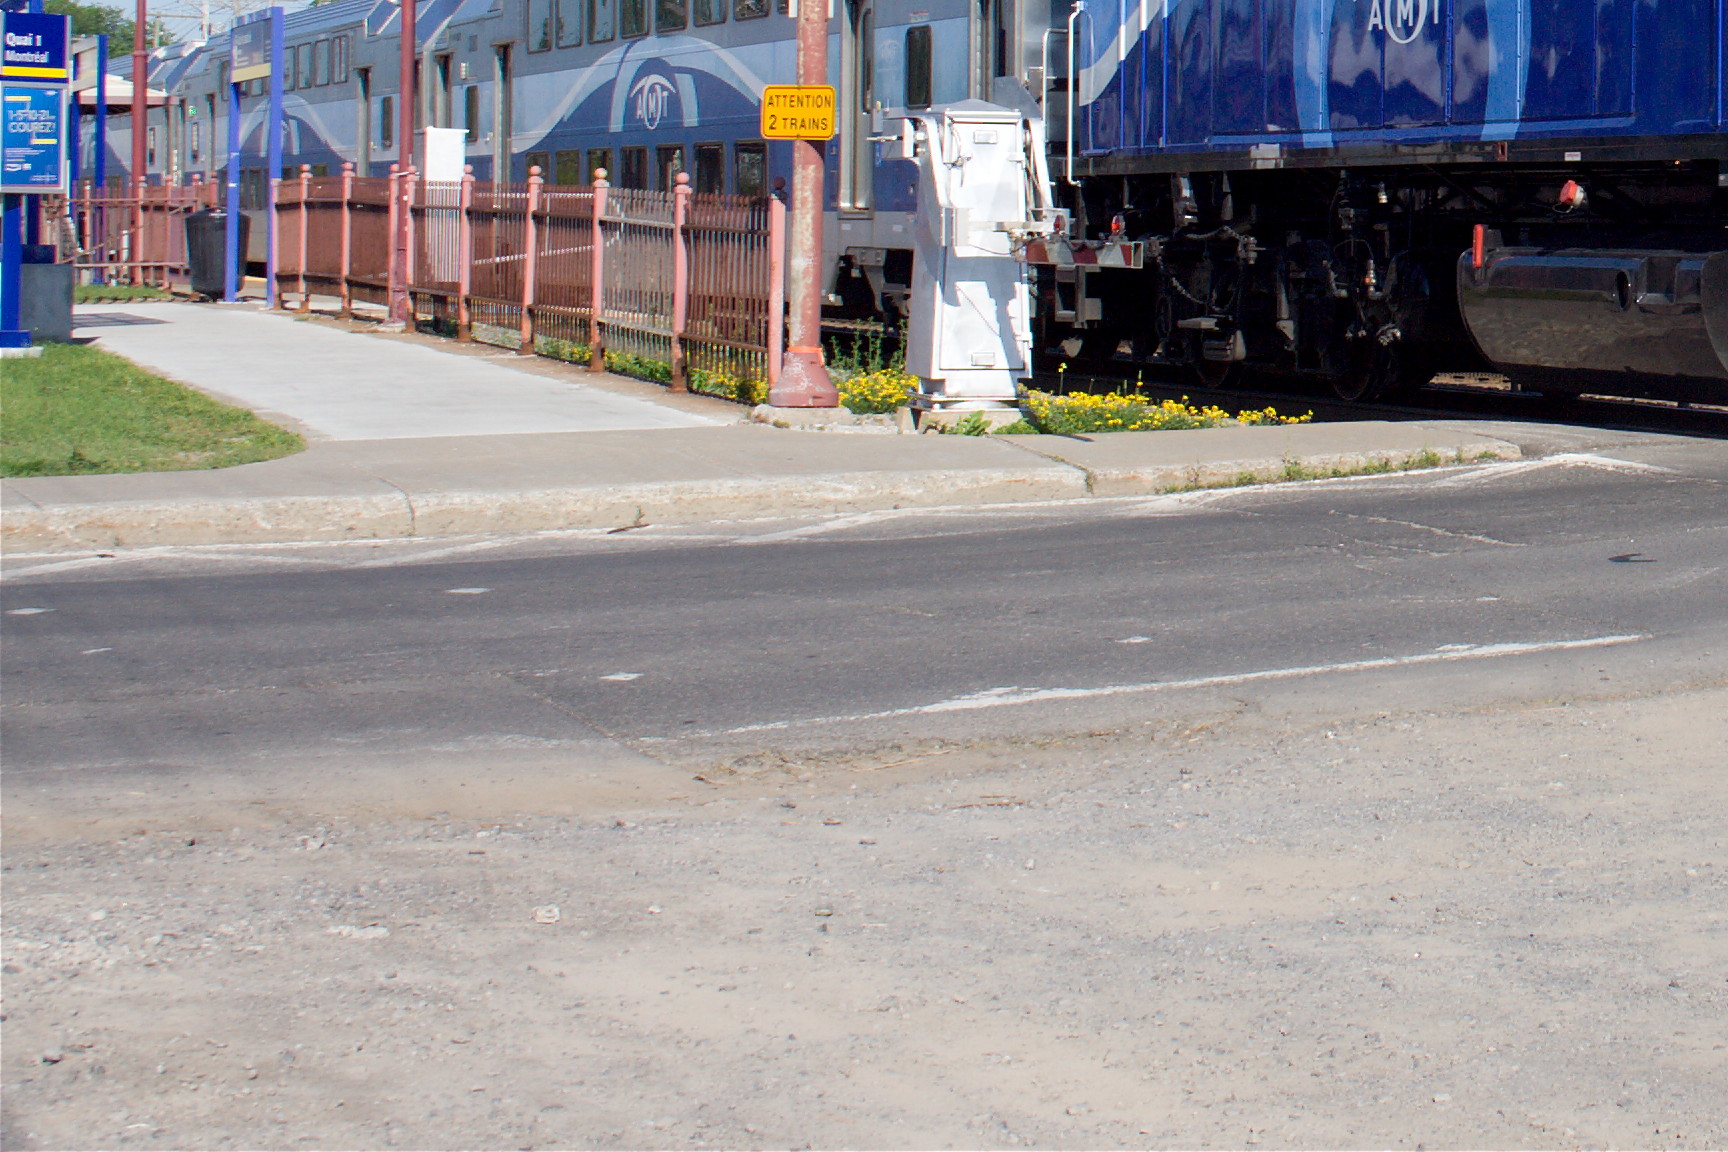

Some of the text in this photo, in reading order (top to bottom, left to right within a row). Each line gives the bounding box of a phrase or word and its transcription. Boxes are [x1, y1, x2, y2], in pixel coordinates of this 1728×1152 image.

[5, 32, 33, 47] Quai
[4, 50, 49, 63] Montréal
[767, 94, 831, 108] ATTENTION
[768, 114, 828, 131] 2 TRAINS
